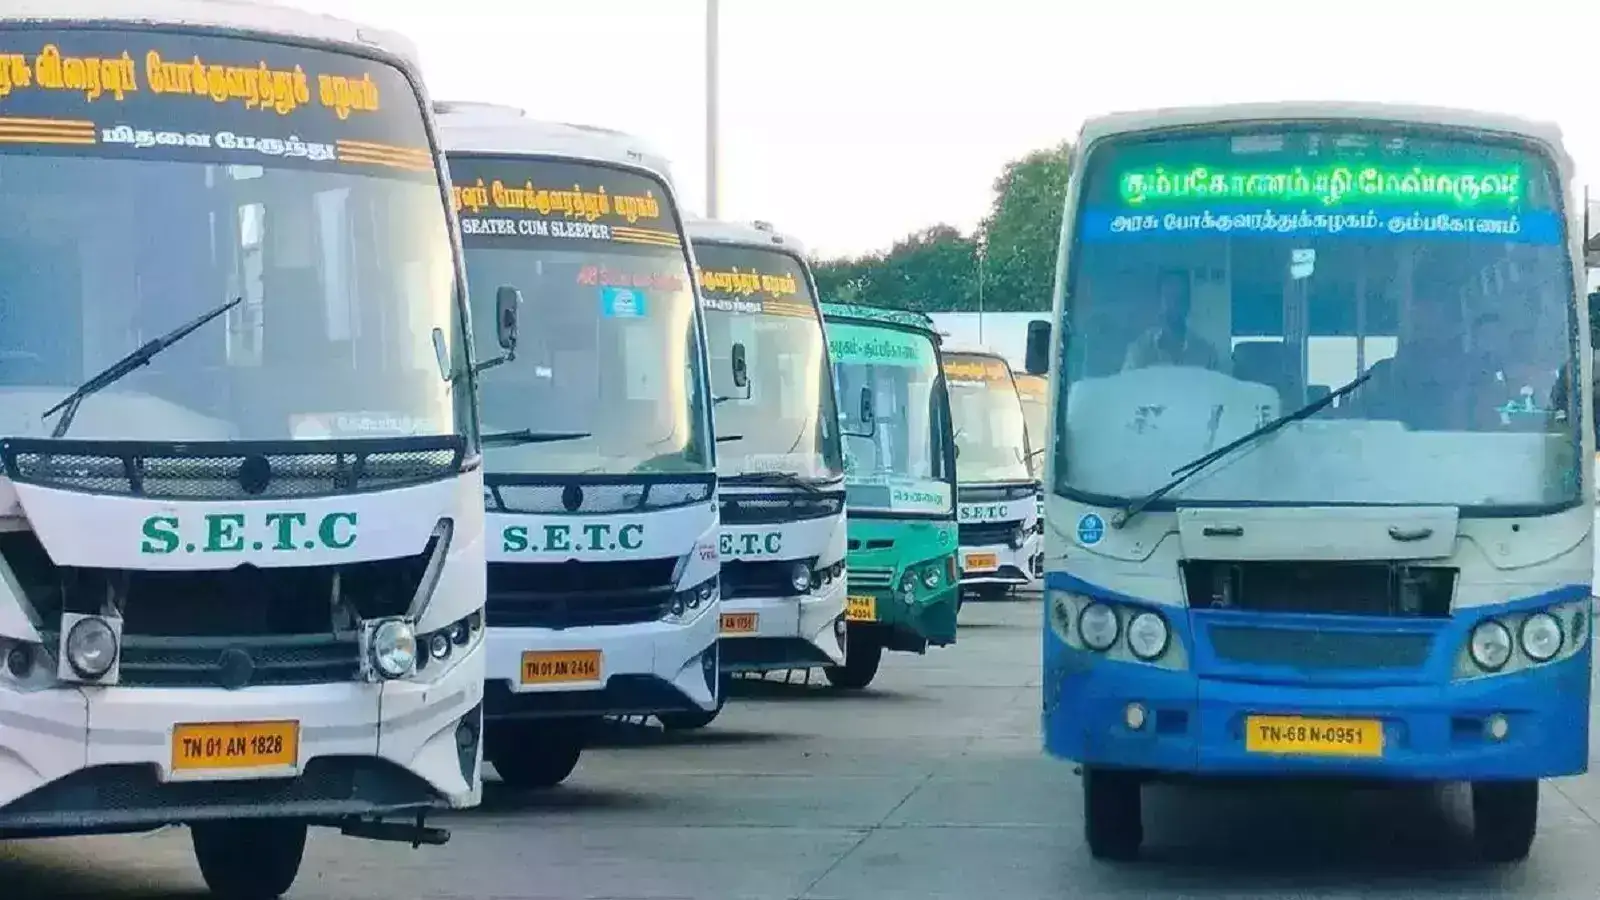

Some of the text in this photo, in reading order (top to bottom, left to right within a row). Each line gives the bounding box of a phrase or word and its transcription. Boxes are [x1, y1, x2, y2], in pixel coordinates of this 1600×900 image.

[102, 125, 212, 148] மிதவை
[462, 219, 611, 240] SEATER CUM SLEEPER
[1110, 214, 1158, 232] அரசு
[1387, 211, 1520, 234] கும்பகோணம்
[141, 512, 358, 554] S.E.T.C
[503, 524, 645, 552] S.E.T.C
[540, 662, 552, 675] 01
[554, 661, 568, 675] AN
[1259, 725, 1306, 742] TN-68
[182, 735, 283, 757] TN 01 AN 1828
